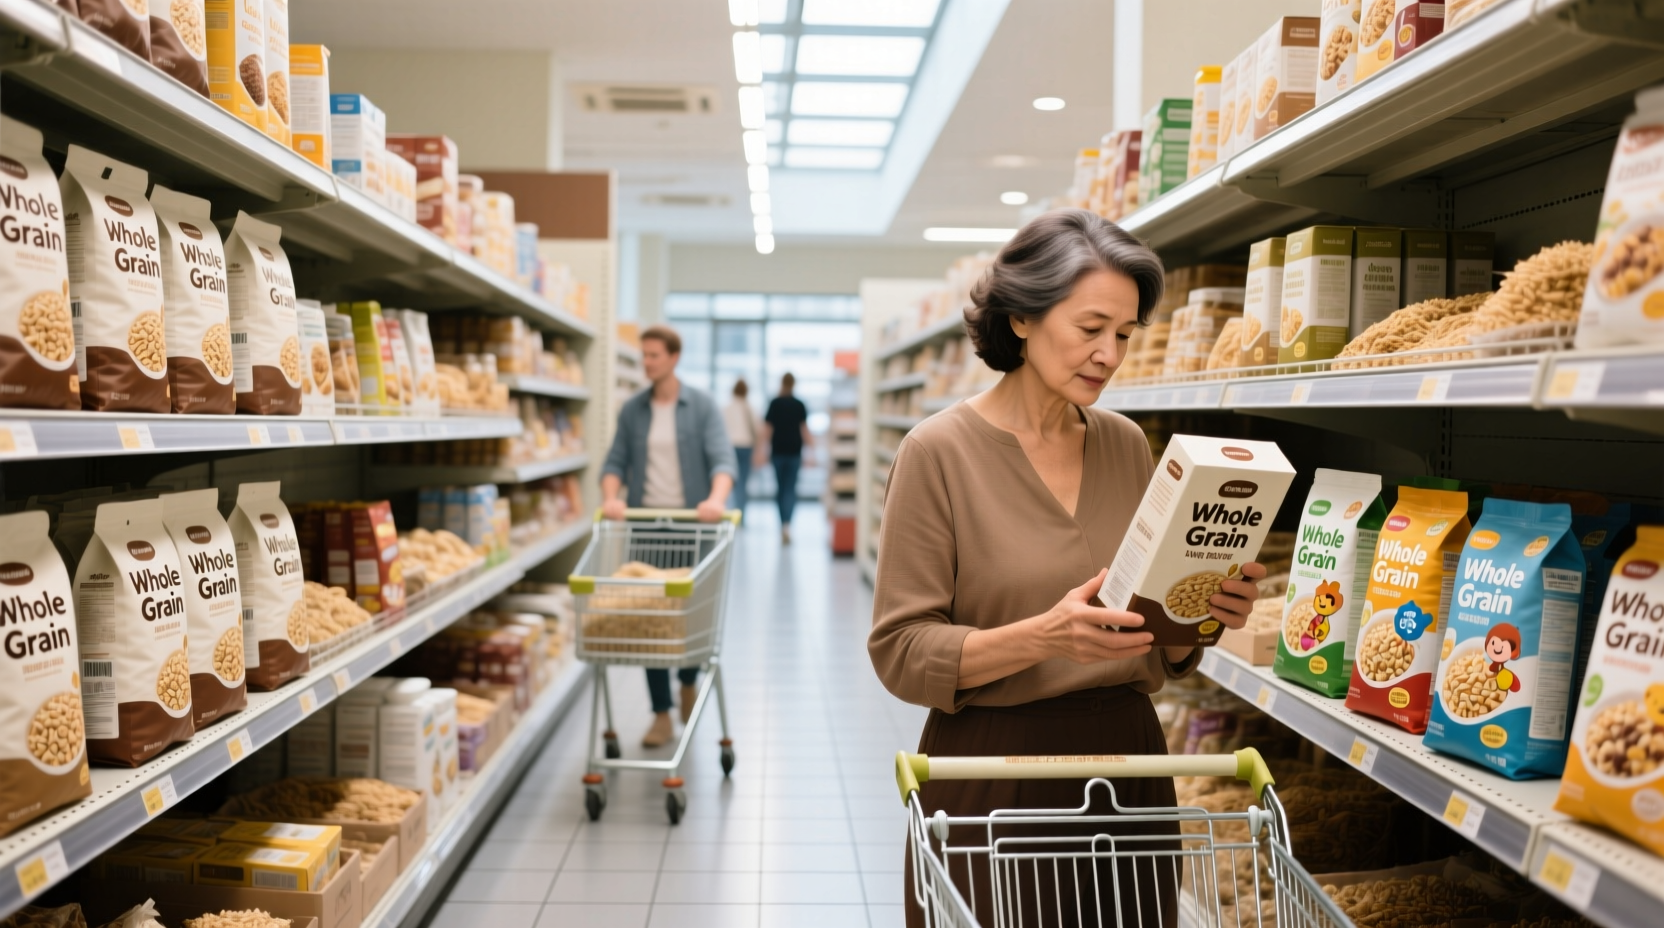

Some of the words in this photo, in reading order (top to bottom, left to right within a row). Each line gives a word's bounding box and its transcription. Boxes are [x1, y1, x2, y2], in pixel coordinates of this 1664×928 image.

[0, 214, 62, 253] Grain
[104, 218, 157, 252] Whole
[114, 248, 160, 278] Grain
[189, 267, 226, 294] Grain
[1192, 502, 1263, 527] Whole
[1185, 526, 1249, 549] Grain
[1302, 524, 1345, 549] Whole
[188, 549, 234, 575] Whole
[1298, 545, 1337, 571] Grain
[1378, 538, 1427, 566] Whole
[129, 564, 181, 595] Whole
[198, 573, 237, 600] Grain
[1373, 560, 1419, 589] Grain
[1464, 557, 1525, 589] Whole
[0, 590, 67, 627] Whole
[141, 591, 184, 622] Grain
[1457, 583, 1513, 615] Grain
[1611, 589, 1664, 623] Who
[4, 627, 71, 660] Grain
[1606, 621, 1664, 659] Grai
